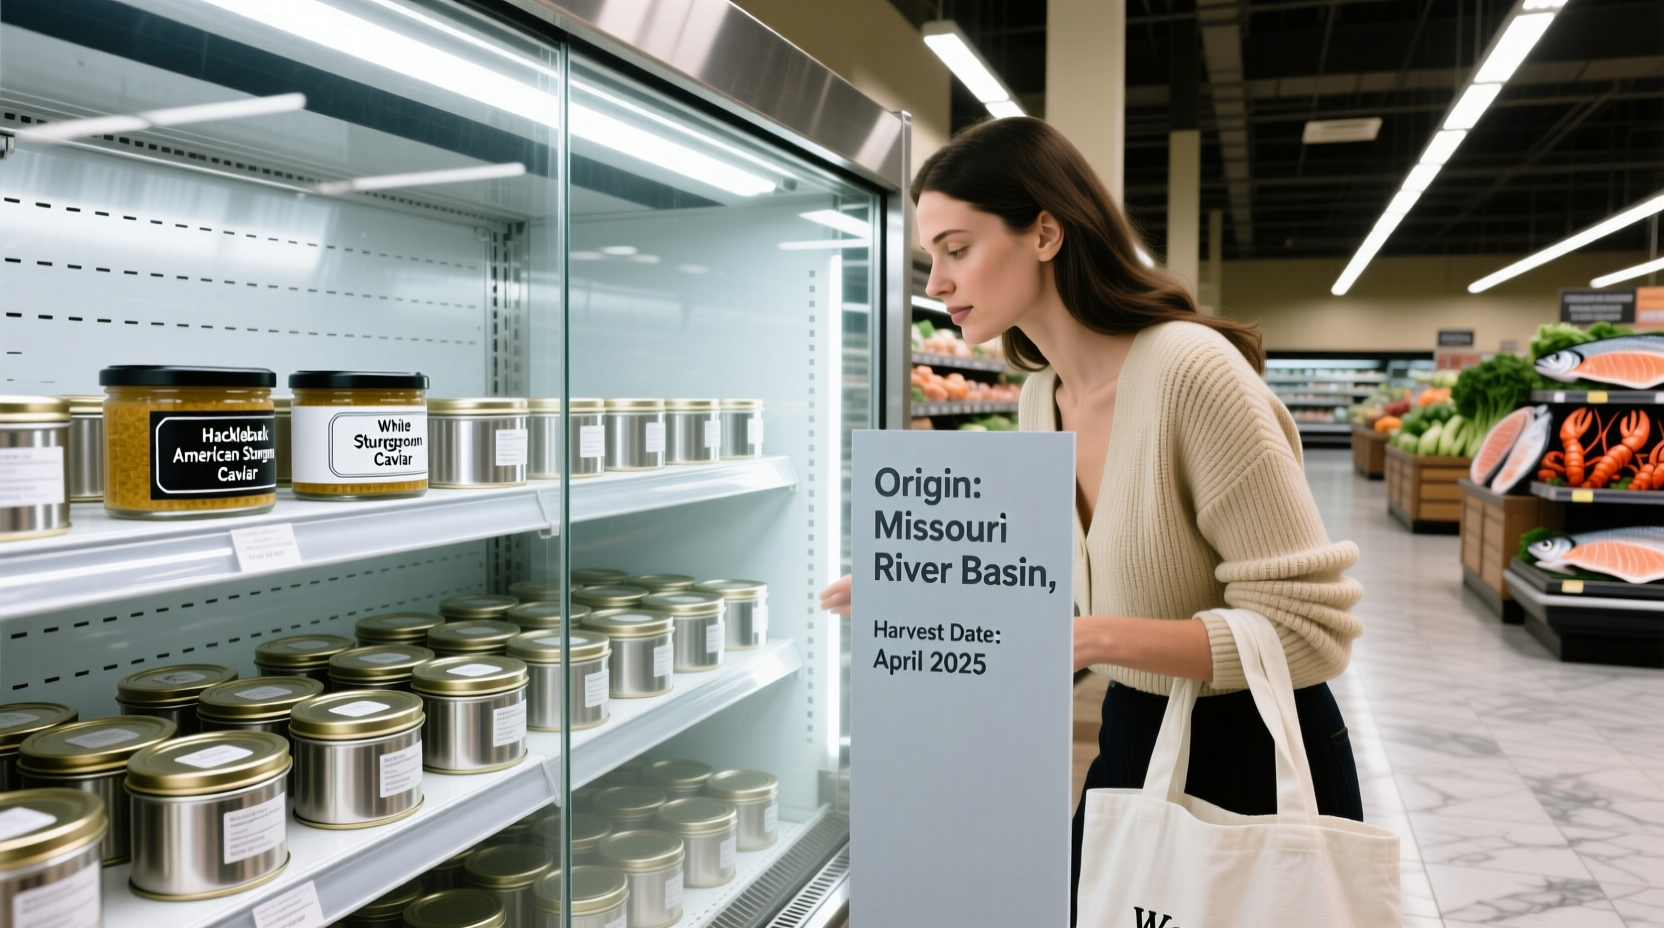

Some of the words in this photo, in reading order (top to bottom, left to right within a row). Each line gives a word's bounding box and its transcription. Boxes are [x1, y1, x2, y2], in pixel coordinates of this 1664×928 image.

[172, 445, 240, 463] American
[874, 467, 982, 506] Origin:
[874, 510, 1007, 543] Missouri
[874, 552, 953, 583] River
[961, 555, 1057, 594] Basin,
[873, 619, 945, 641] Harvest
[950, 622, 1001, 644] Date:
[873, 648, 923, 676] April
[930, 650, 987, 676] 2025
